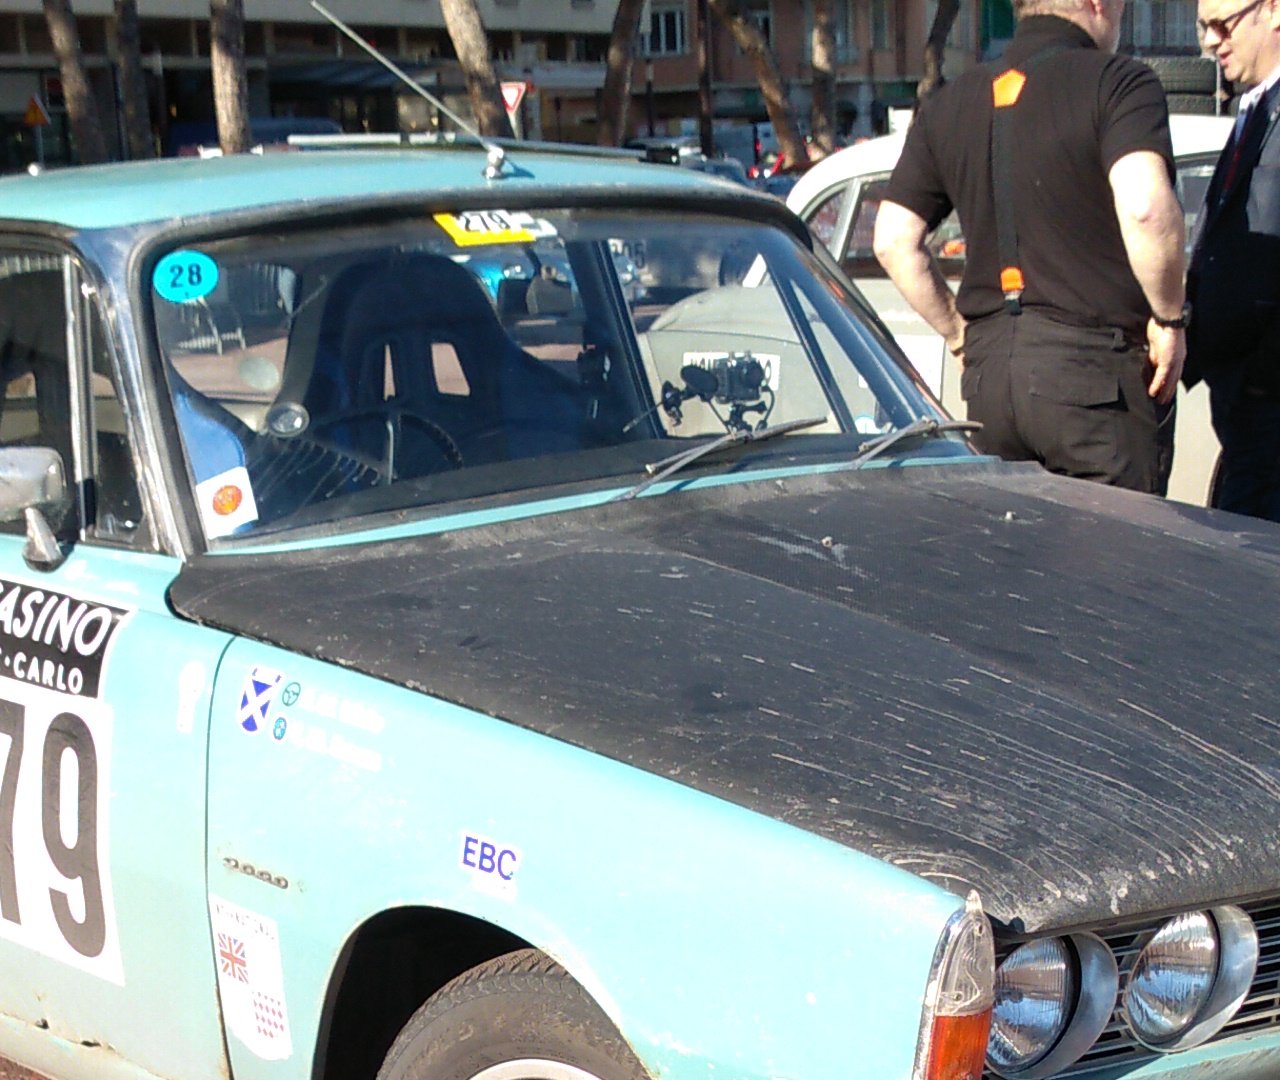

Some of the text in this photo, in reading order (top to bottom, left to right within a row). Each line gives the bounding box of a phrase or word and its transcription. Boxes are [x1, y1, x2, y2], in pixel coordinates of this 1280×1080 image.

[460, 211, 510, 232] 279
[170, 264, 202, 288] 28
[463, 835, 517, 881] EBC
